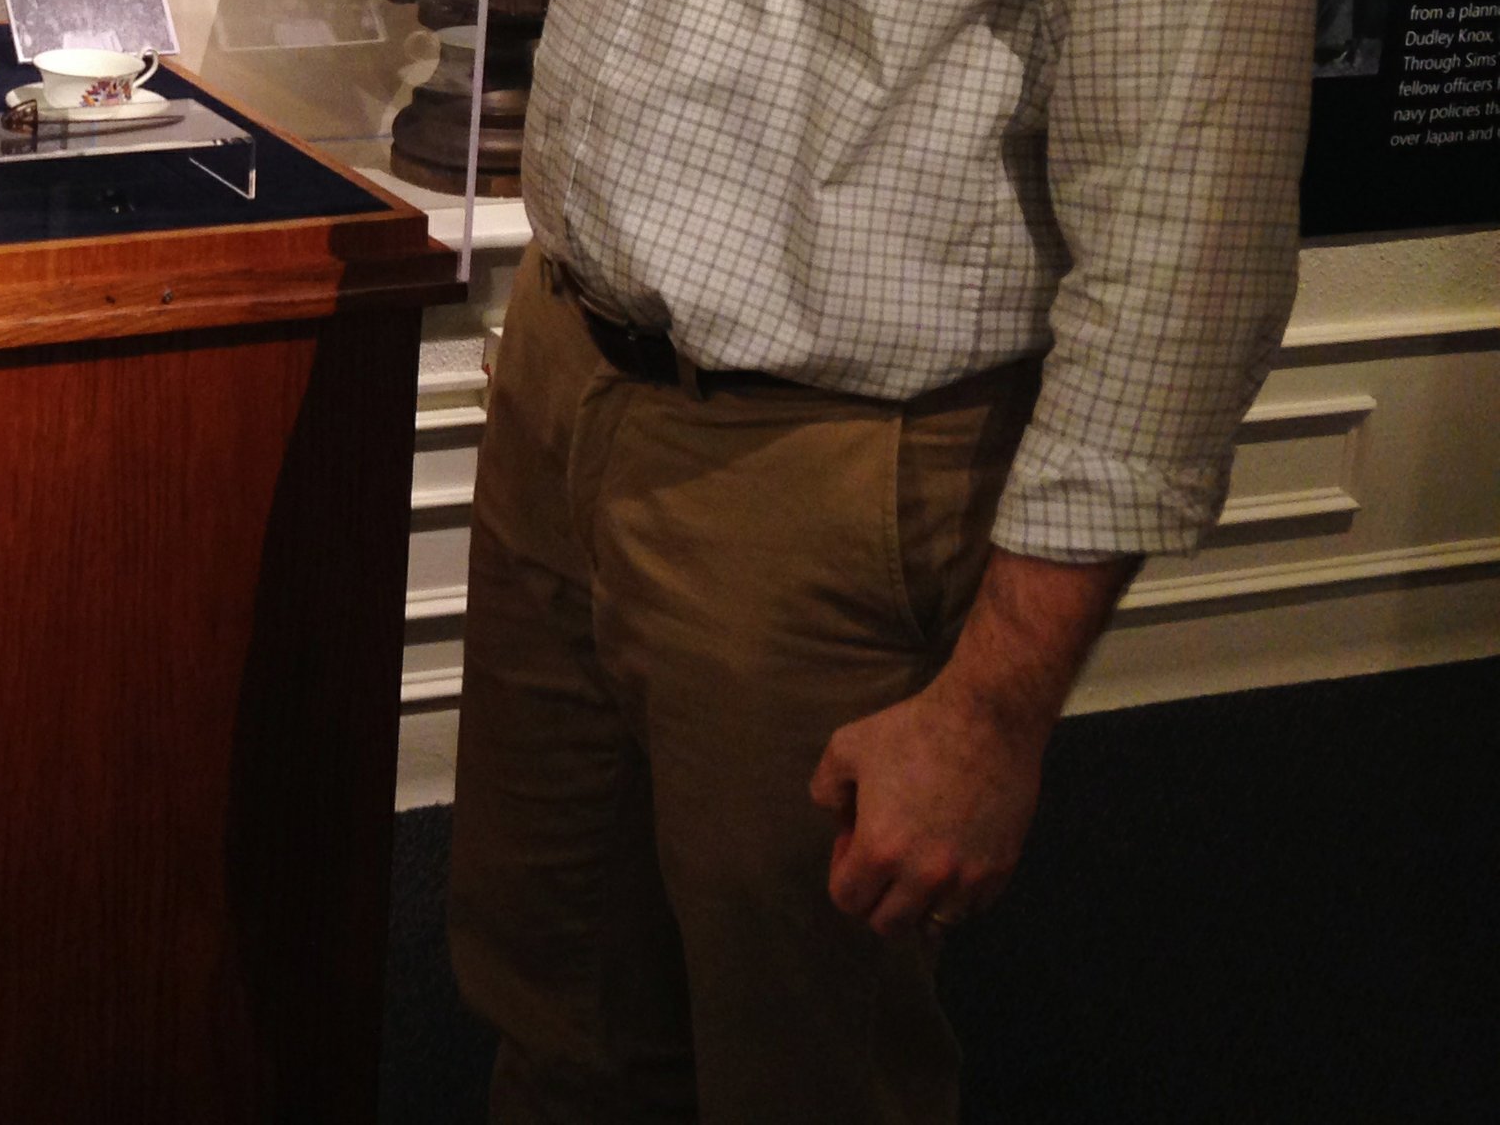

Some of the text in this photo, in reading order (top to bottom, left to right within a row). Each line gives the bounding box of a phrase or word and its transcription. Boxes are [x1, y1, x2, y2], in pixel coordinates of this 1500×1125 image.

[1411, 5, 1443, 20] from
[1447, 6, 1455, 19] a
[1405, 29, 1493, 48] Dudley Knox,
[1404, 54, 1461, 73] Through
[1399, 80, 1440, 97] fellow
[1444, 77, 1493, 94] officers
[1394, 108, 1426, 123] navy
[1429, 103, 1480, 123] policies
[1391, 132, 1420, 146] over
[1425, 129, 1463, 146] Japan
[1467, 126, 1493, 141] and
